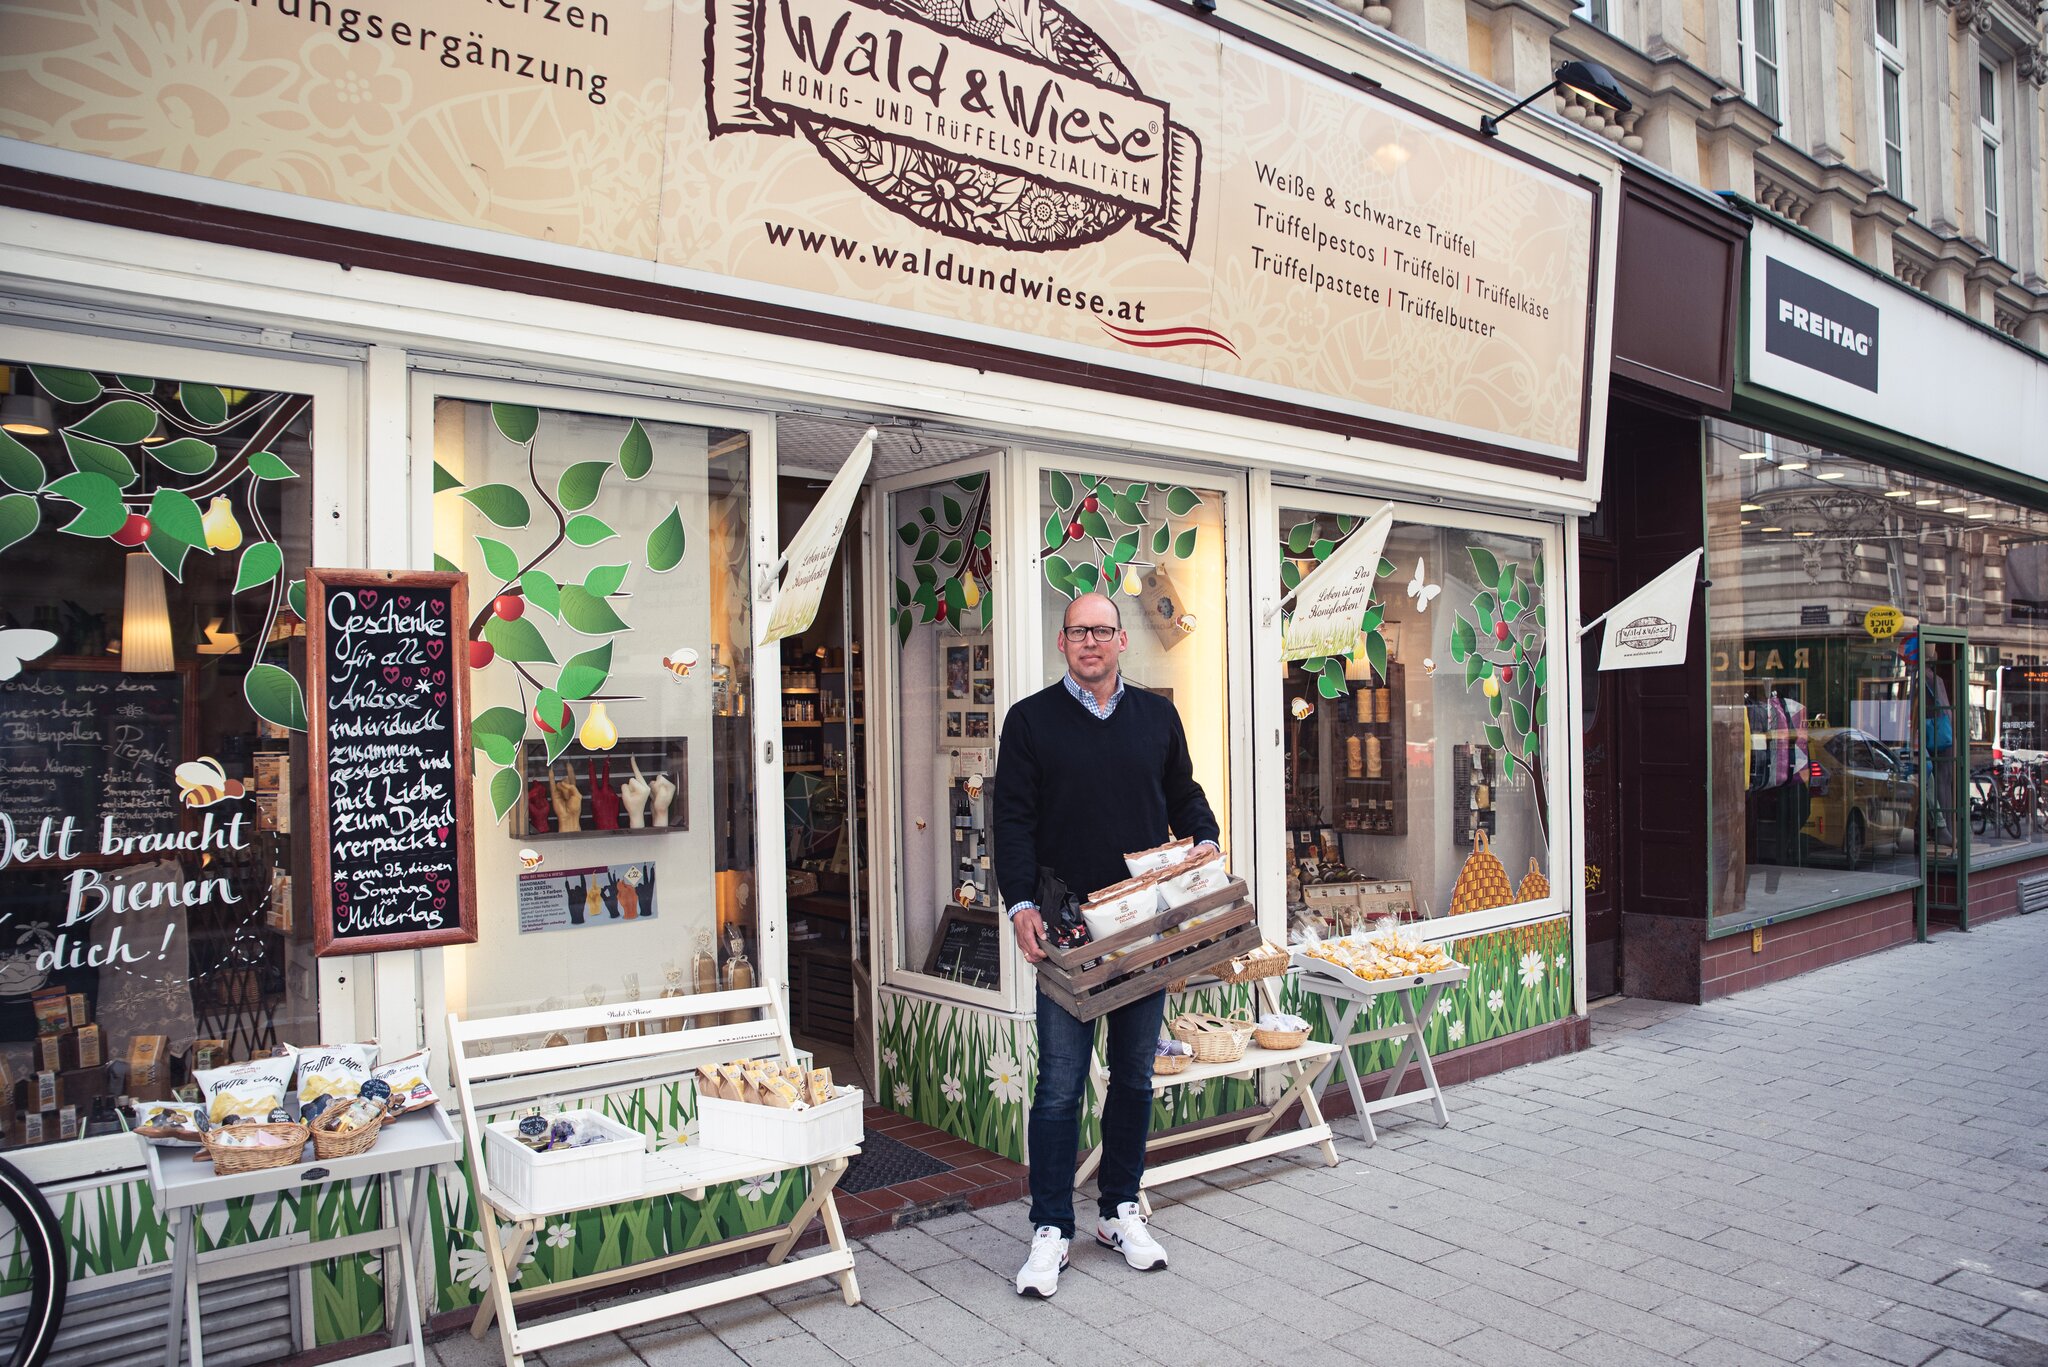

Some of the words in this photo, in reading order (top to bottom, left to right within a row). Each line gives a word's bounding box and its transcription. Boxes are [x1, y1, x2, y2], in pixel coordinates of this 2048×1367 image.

[779, 0, 949, 107] Wald
[960, 69, 996, 119] &
[876, 98, 912, 126] UND
[925, 112, 1151, 196] TRÜFFELSPEZIALITÄTEN
[1254, 160, 1316, 202] Weiße
[1324, 187, 1337, 209] &
[1344, 197, 1422, 240] schwarze
[1426, 223, 1477, 259] Trüffel
[764, 221, 1146, 324] www.waldundwiese.at
[1253, 203, 1376, 263] Trüffelpestos
[1393, 249, 1460, 291] Trüffelöl
[1475, 278, 1550, 321] Trüffelkäse
[1251, 245, 1380, 304] Trüffelpastete
[1398, 290, 1496, 338] Trüffelbutter
[1353, 565, 1370, 581] Das
[1309, 594, 1364, 619] Honiglecken!
[1317, 586, 1341, 602] Leben
[1342, 585, 1352, 597] ist
[1352, 583, 1365, 596] ein
[328, 592, 446, 661] Geschenke
[1622, 629, 1641, 637] Wald
[1648, 626, 1669, 635] Wiese
[331, 640, 376, 683] für
[380, 637, 427, 665] alle
[116, 679, 158, 693] dem
[4, 720, 103, 752] Blütenpollen
[328, 708, 446, 741] individuell
[114, 724, 173, 770] Propolis
[330, 758, 409, 798] gestellt
[419, 750, 451, 770] und
[331, 780, 377, 813] mit
[382, 773, 447, 806] Liebe
[100, 812, 252, 856] braucht
[333, 812, 390, 836] zum
[389, 799, 456, 835] Detail
[352, 868, 384, 882] am
[408, 862, 453, 874] diesen
[57, 868, 243, 928] Bienen
[353, 880, 433, 901] Sonntag
[380, 897, 398, 905] ist
[337, 901, 444, 933] Muttertag
[1114, 909, 1138, 921] GIANCARLO
[607, 1010, 626, 1019] Wald
[633, 1008, 652, 1016] Wiese
[300, 1055, 335, 1078] Truffle
[339, 1056, 363, 1073] chips
